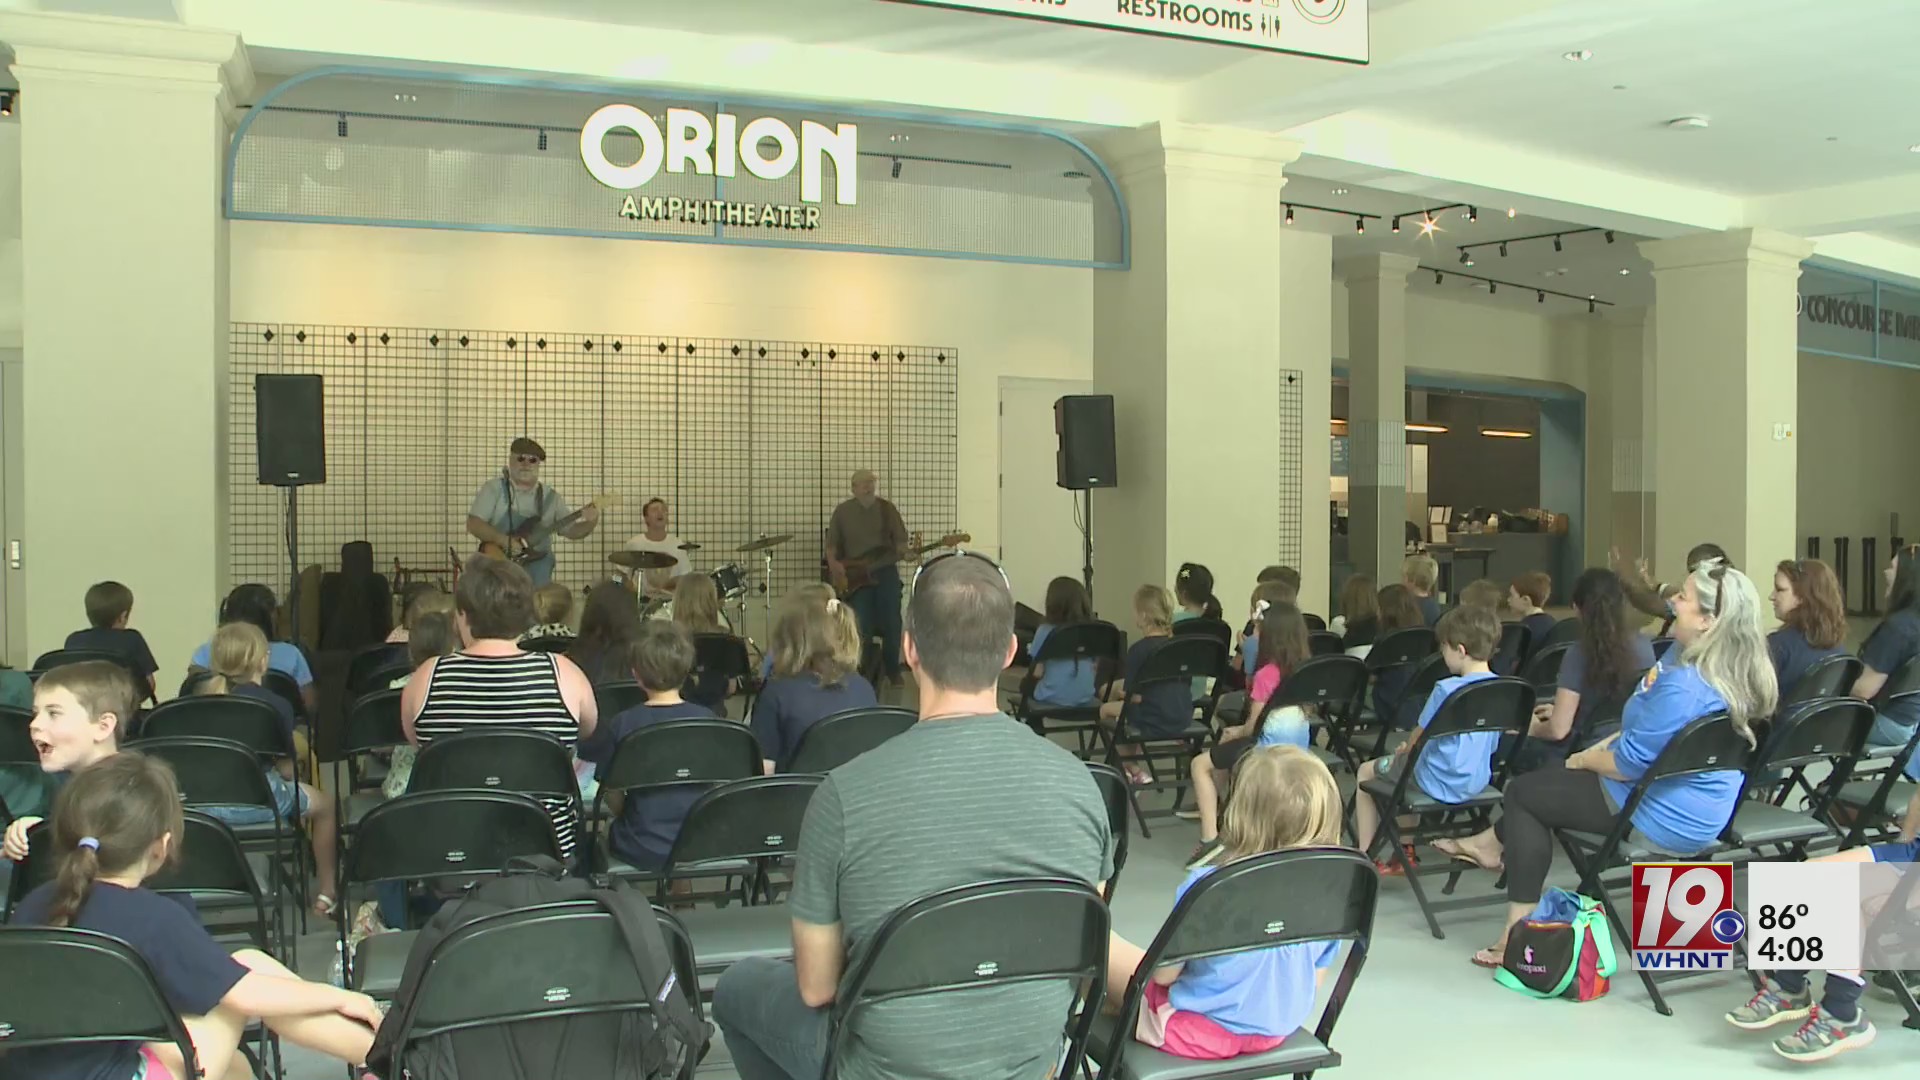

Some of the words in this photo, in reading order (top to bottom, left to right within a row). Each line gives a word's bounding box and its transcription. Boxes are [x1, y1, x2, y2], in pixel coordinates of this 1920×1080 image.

[1117, 0, 1253, 32] RESTROOMS
[580, 104, 857, 205] ORION
[620, 194, 821, 228] AMPHITHEATER
